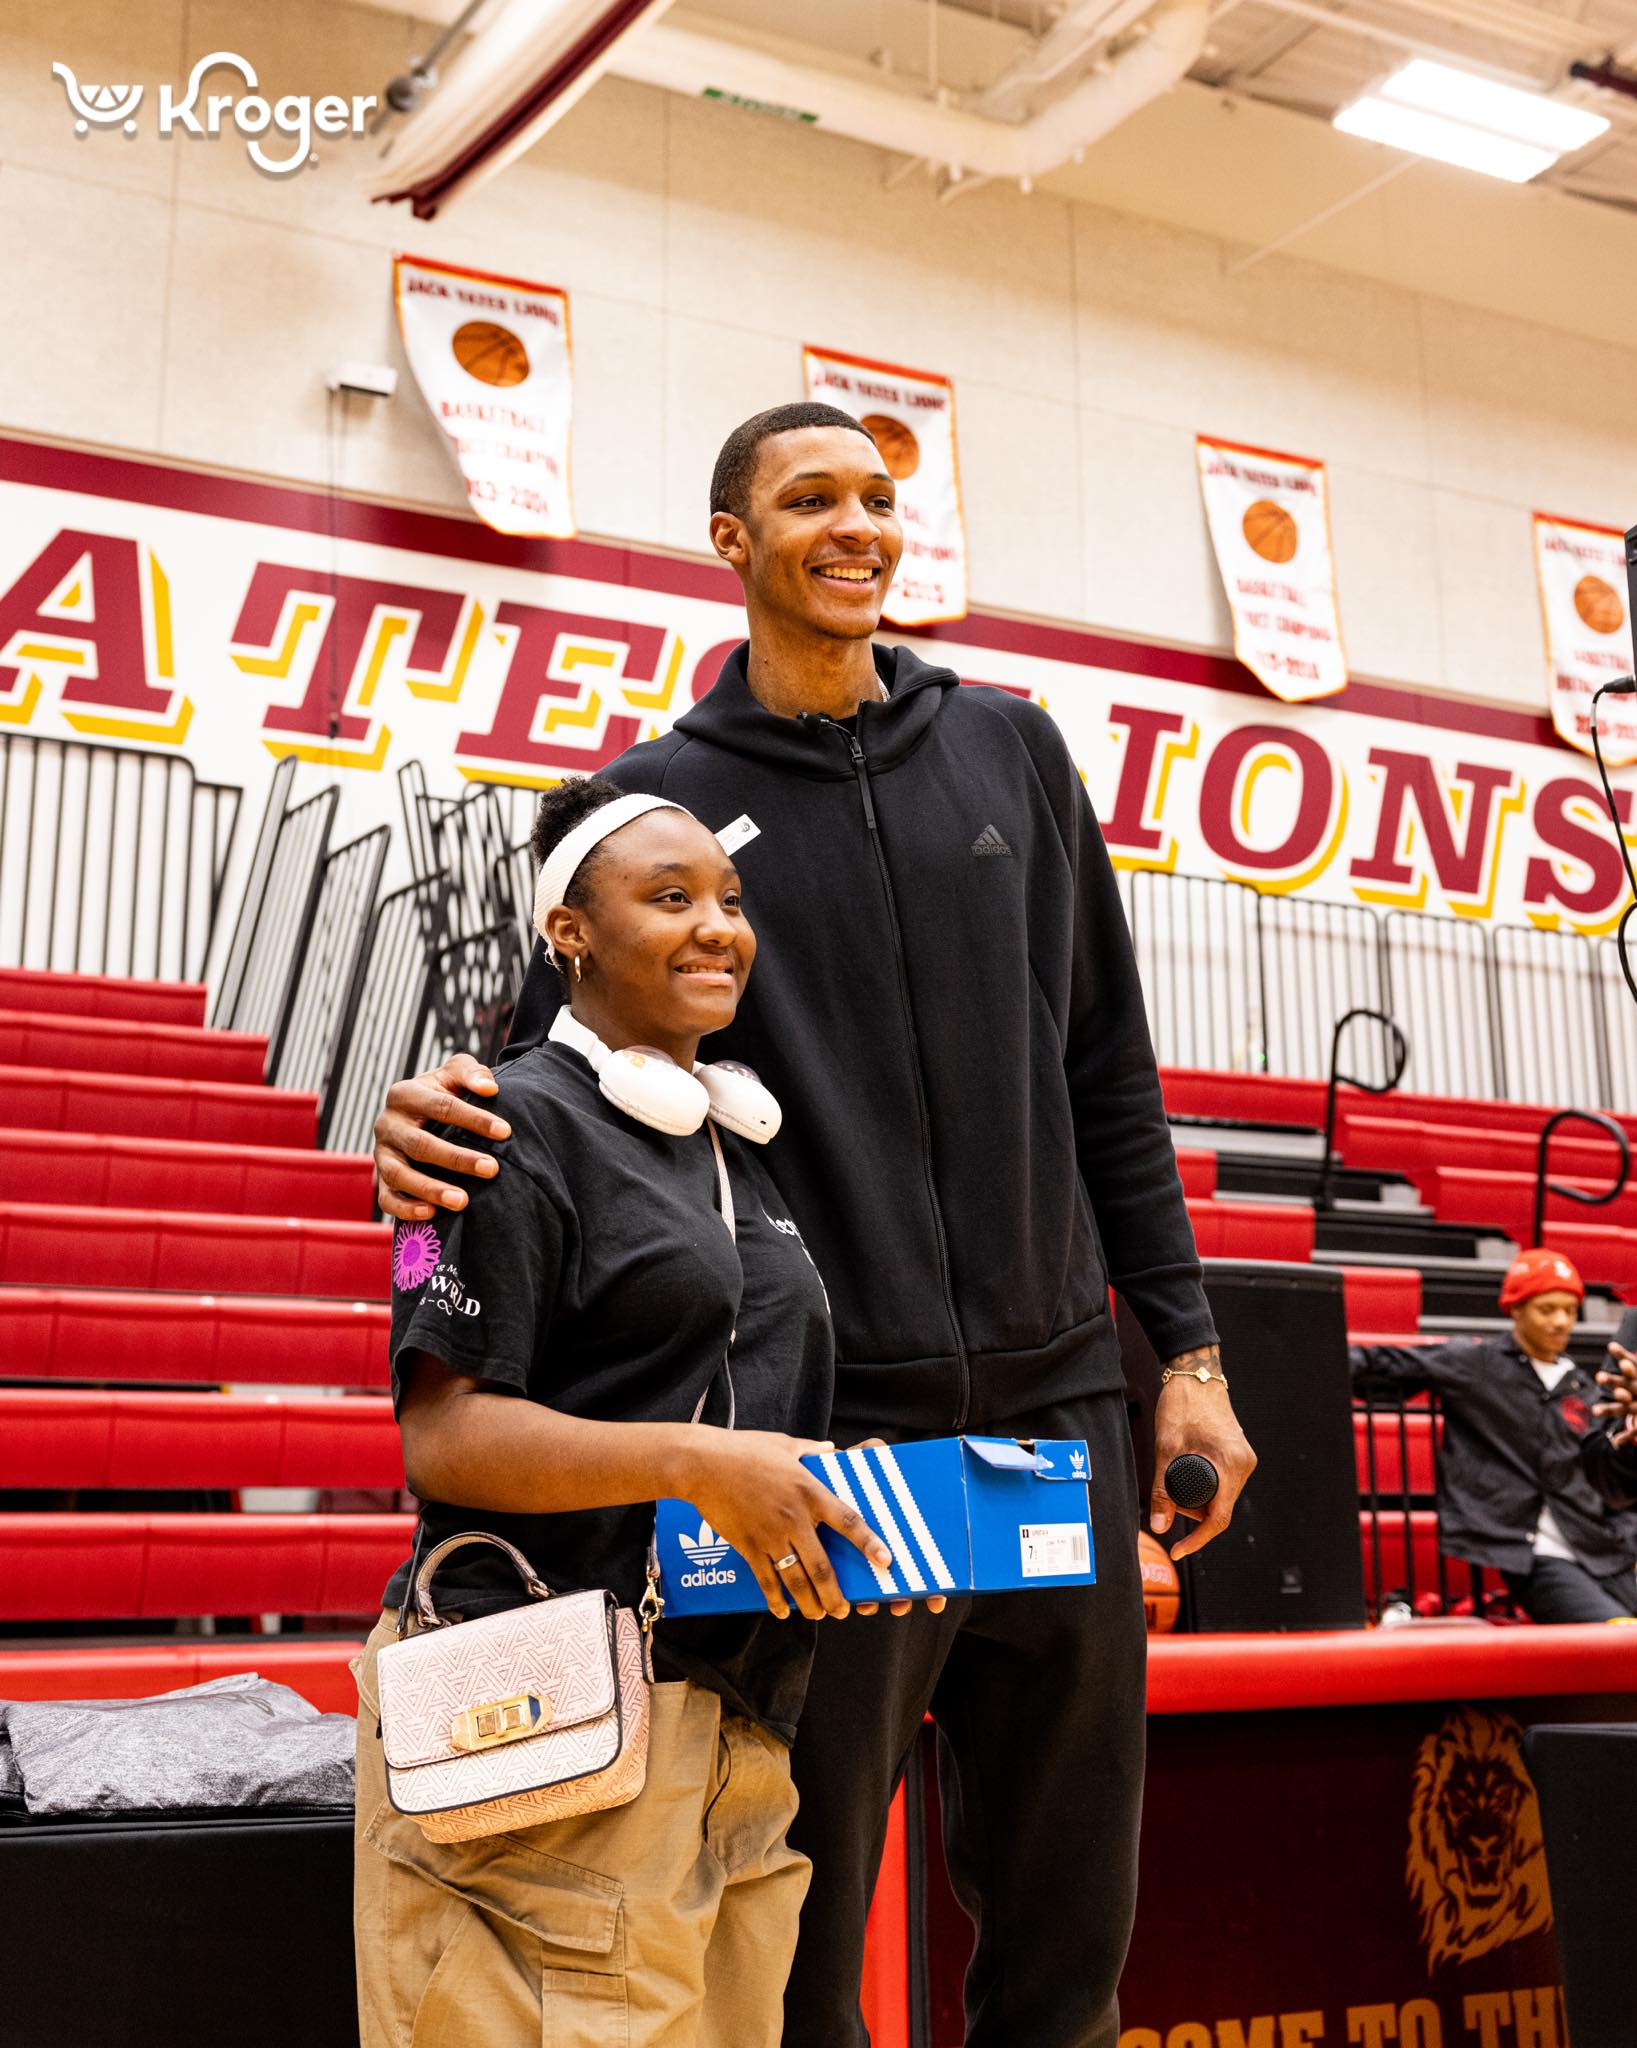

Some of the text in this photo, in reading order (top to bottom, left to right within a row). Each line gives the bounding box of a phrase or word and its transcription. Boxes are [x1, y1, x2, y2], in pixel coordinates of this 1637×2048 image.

[1096, 703, 1637, 936] IONS
[974, 844, 1012, 856] adidas
[431, 1275, 481, 1317] WRLD
[680, 1567, 737, 1588] adidas
[1346, 1997, 1442, 2048] TO
[1462, 1985, 1571, 2048] TH
